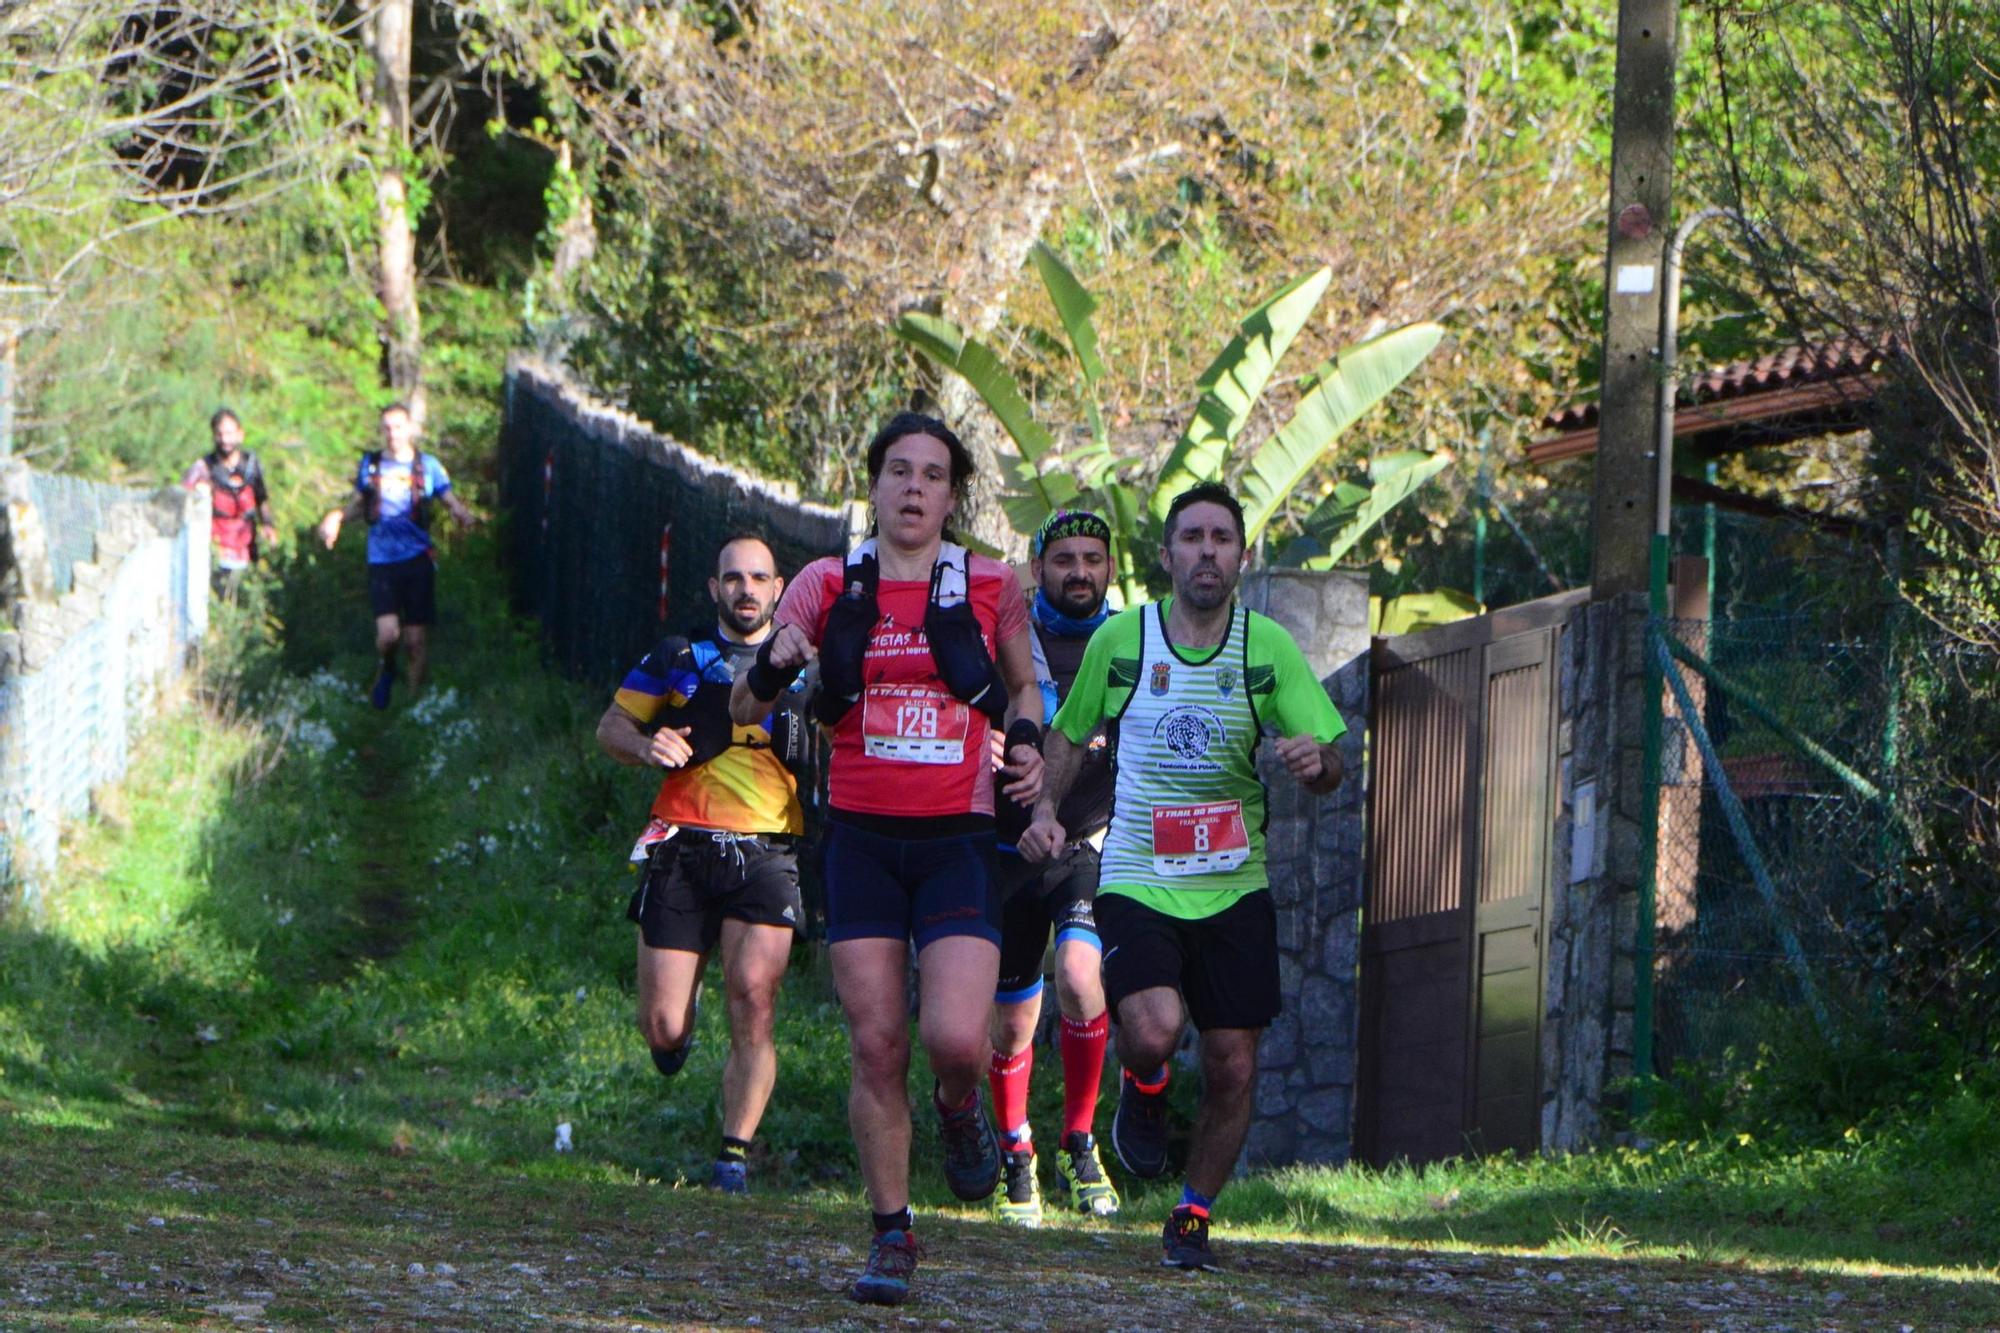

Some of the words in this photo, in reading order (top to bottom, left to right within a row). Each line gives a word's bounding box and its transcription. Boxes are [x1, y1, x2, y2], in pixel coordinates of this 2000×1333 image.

[896, 705, 937, 738] 129
[1165, 809, 1192, 818] TRAIL
[1193, 807, 1206, 816] DO
[1194, 824, 1209, 852] 8
